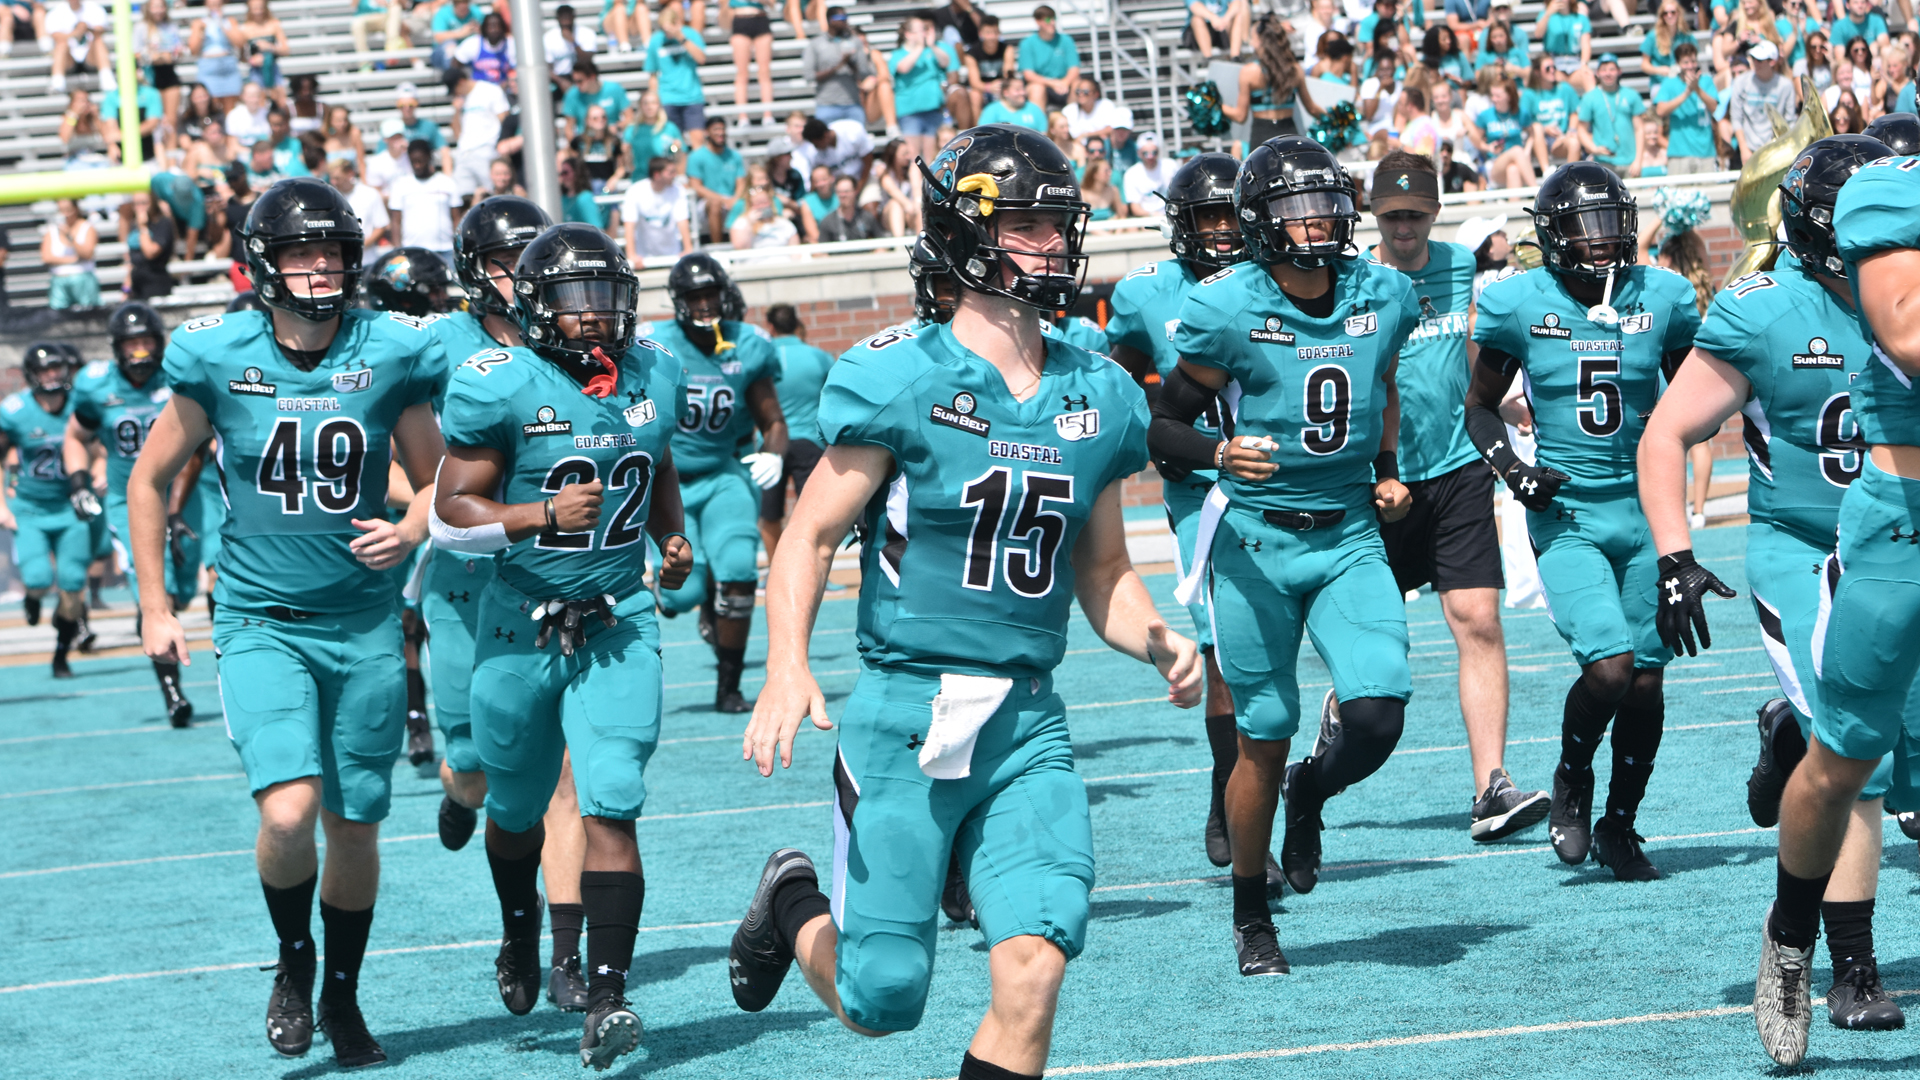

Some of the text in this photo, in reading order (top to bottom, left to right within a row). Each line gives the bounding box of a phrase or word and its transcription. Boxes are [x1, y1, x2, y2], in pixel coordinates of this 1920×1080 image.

[1297, 344, 1354, 360] COASTAL
[1570, 340, 1625, 352] COASTAL
[277, 397, 341, 412] COASTAL
[676, 384, 736, 433] 56
[1301, 364, 1352, 456] 9
[1575, 356, 1624, 437] 5
[575, 432, 636, 449] COASTAL
[988, 440, 1063, 465] COASTAL
[257, 416, 368, 515] 49
[534, 451, 655, 552] 22
[960, 465, 1075, 599] 15
